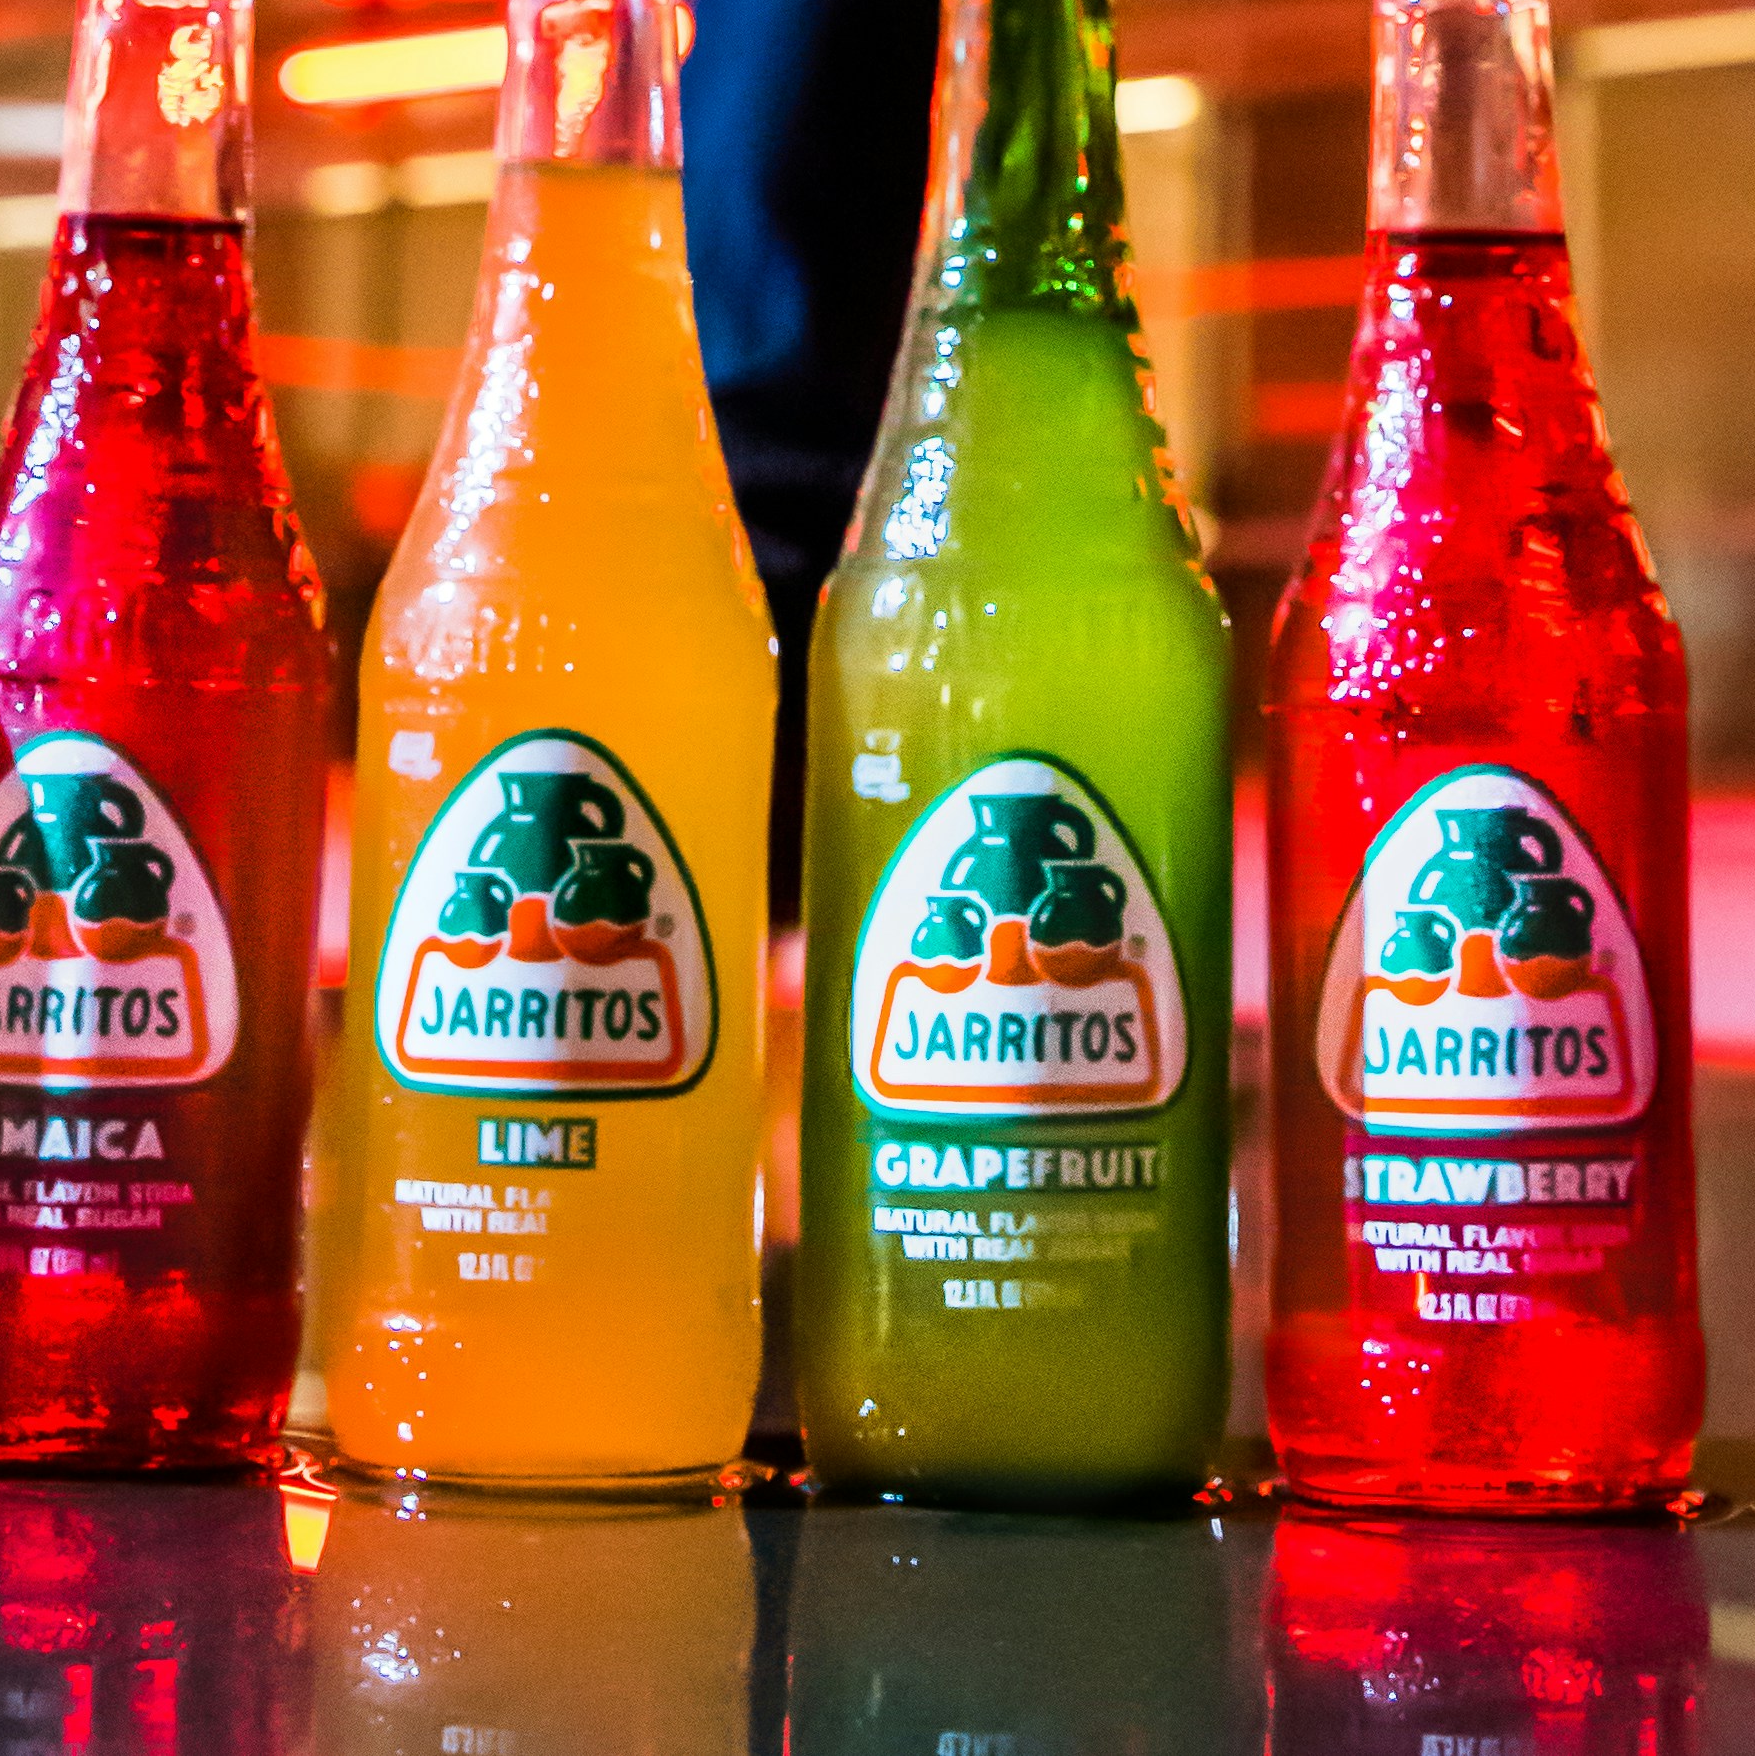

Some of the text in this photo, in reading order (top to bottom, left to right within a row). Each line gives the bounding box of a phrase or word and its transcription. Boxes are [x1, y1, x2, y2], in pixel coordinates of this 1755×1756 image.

[420, 986, 662, 1042] JARRITOS
[894, 1010, 1138, 1063] JARRITOS
[1363, 1026, 1610, 1077] JARRITOS
[478, 1119, 595, 1165] LIME
[874, 1142, 1157, 1190] GRAPEFRUIT
[421, 1207, 483, 1233] WITH
[874, 1206, 983, 1236] NATURAL
[1356, 1220, 1457, 1249] ATURAL
[902, 1234, 968, 1261] WITH
[1375, 1247, 1442, 1274] WITH
[1446, 1249, 1515, 1275] REAL
